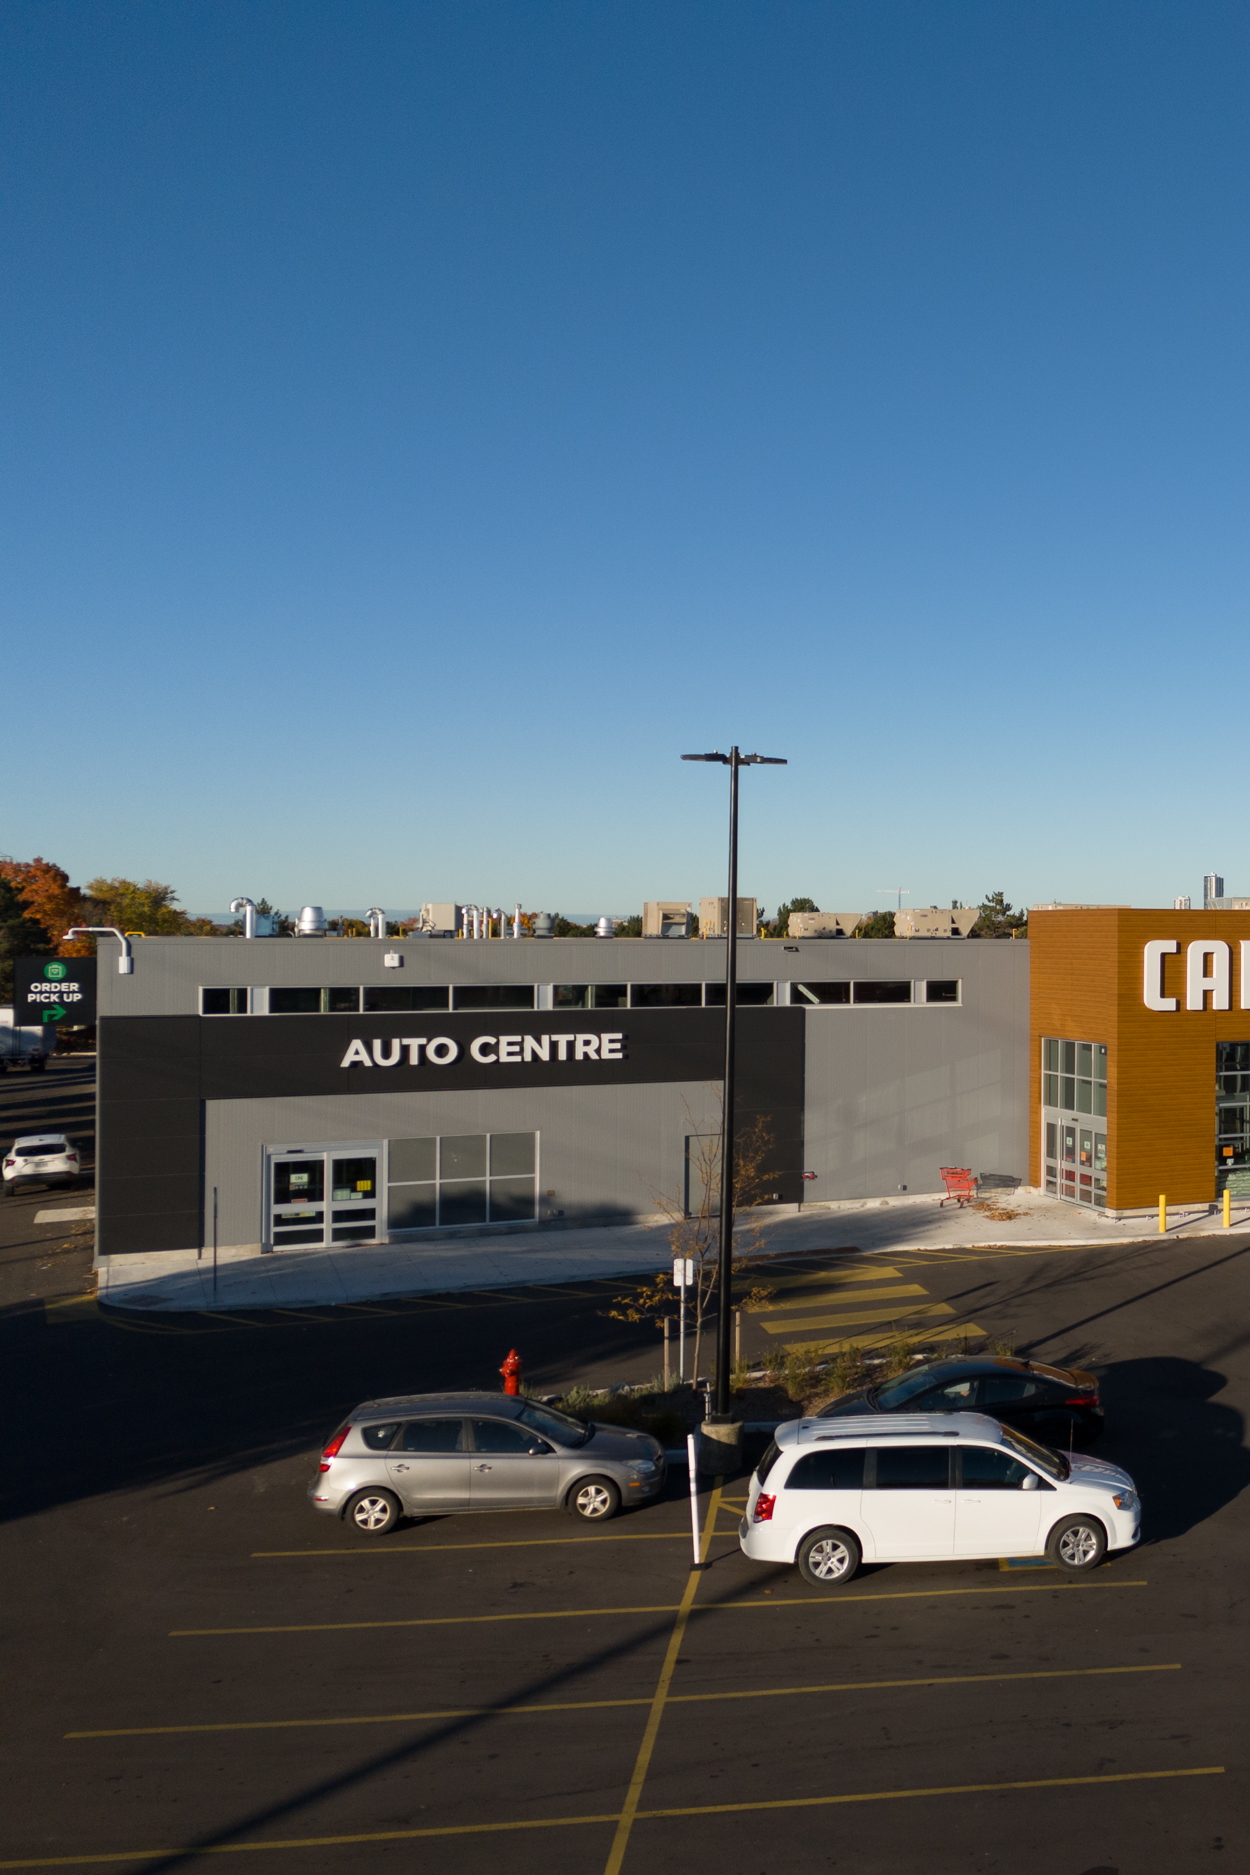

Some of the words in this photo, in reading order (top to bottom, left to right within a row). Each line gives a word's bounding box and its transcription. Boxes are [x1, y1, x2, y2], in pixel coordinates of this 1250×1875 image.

[29, 982, 80, 992] ORDER
[27, 993, 60, 1003] PICK
[63, 993, 83, 1002] UP
[340, 1036, 458, 1068] AUTO
[470, 1032, 624, 1065] CENTRE
